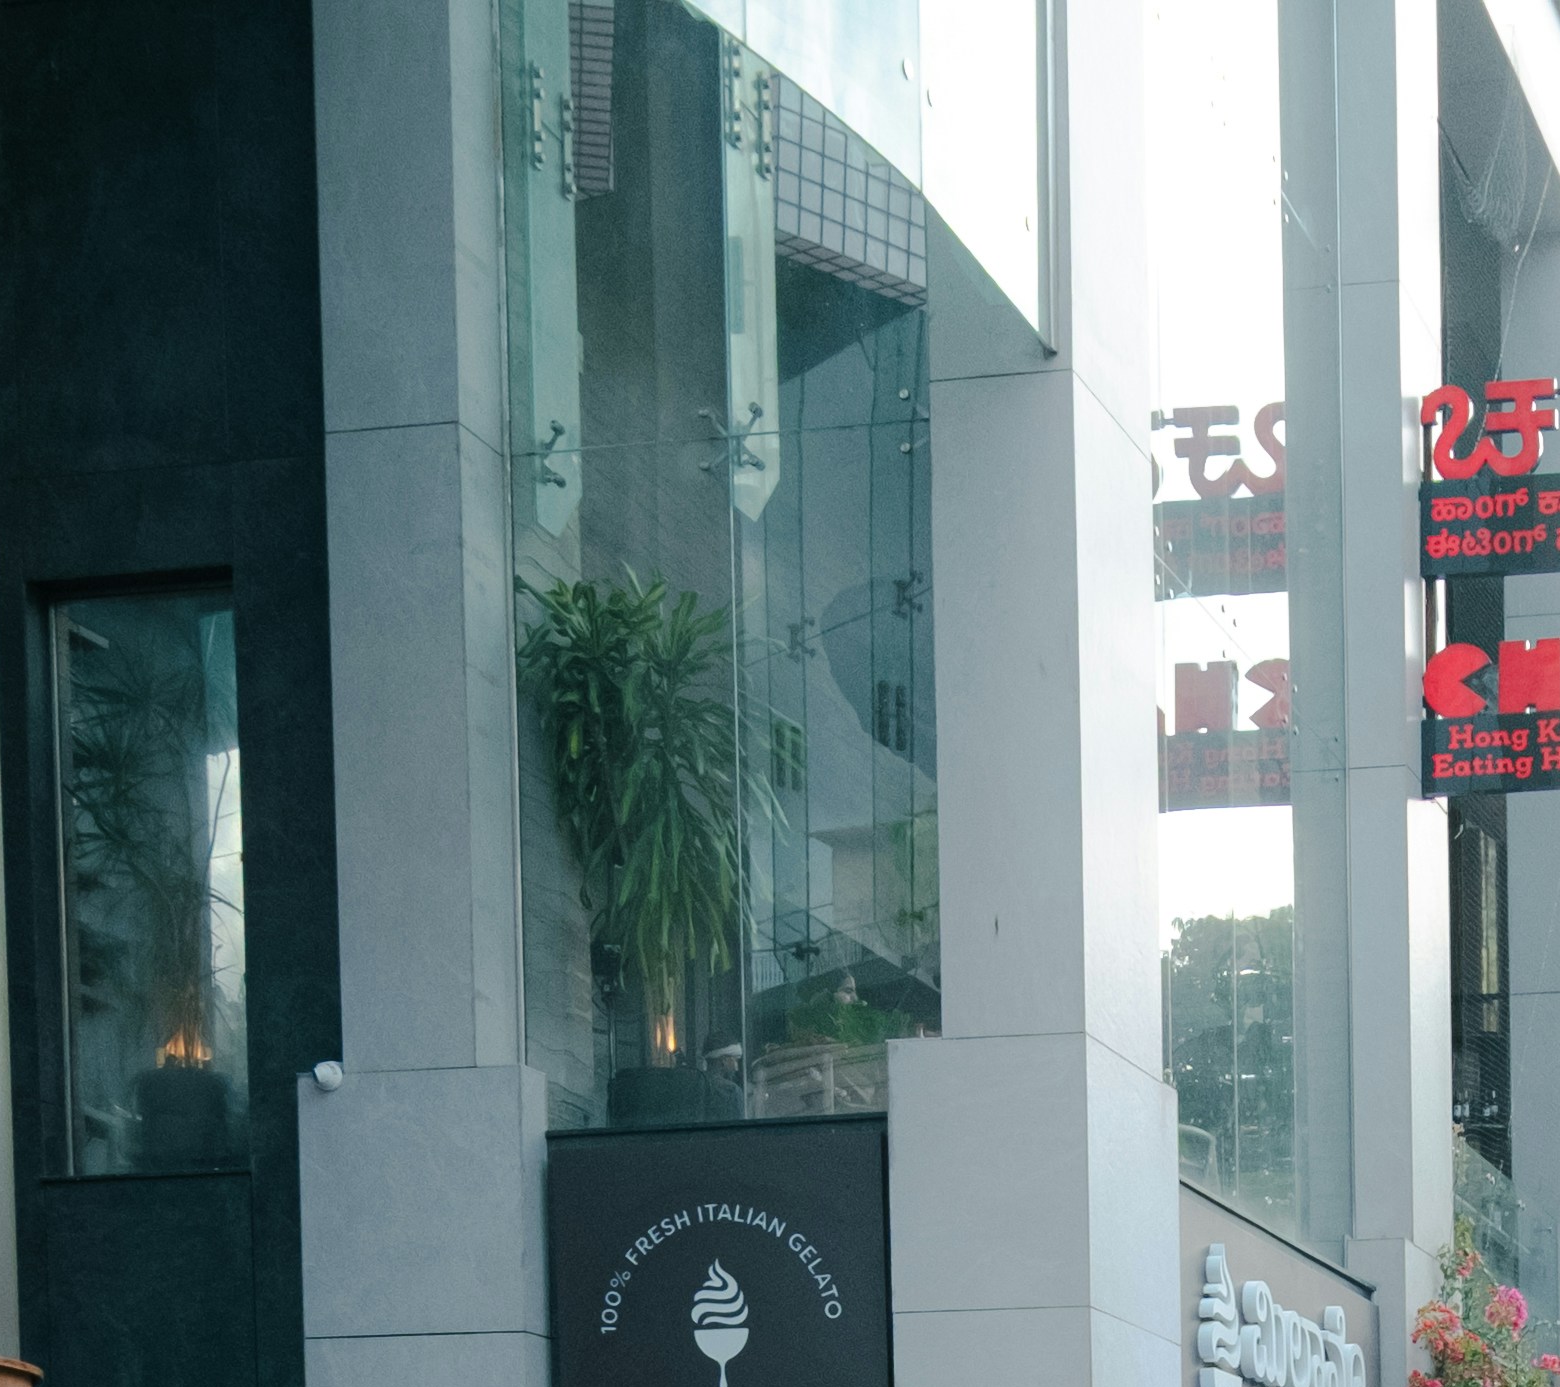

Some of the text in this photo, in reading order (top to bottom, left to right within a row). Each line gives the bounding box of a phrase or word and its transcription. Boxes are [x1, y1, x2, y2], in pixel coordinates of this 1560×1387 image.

[1448, 724, 1528, 754] Hong
[1432, 754, 1533, 782] Eating
[599, 1201, 843, 1334] 100% FRESH ITALIAN GELATO
